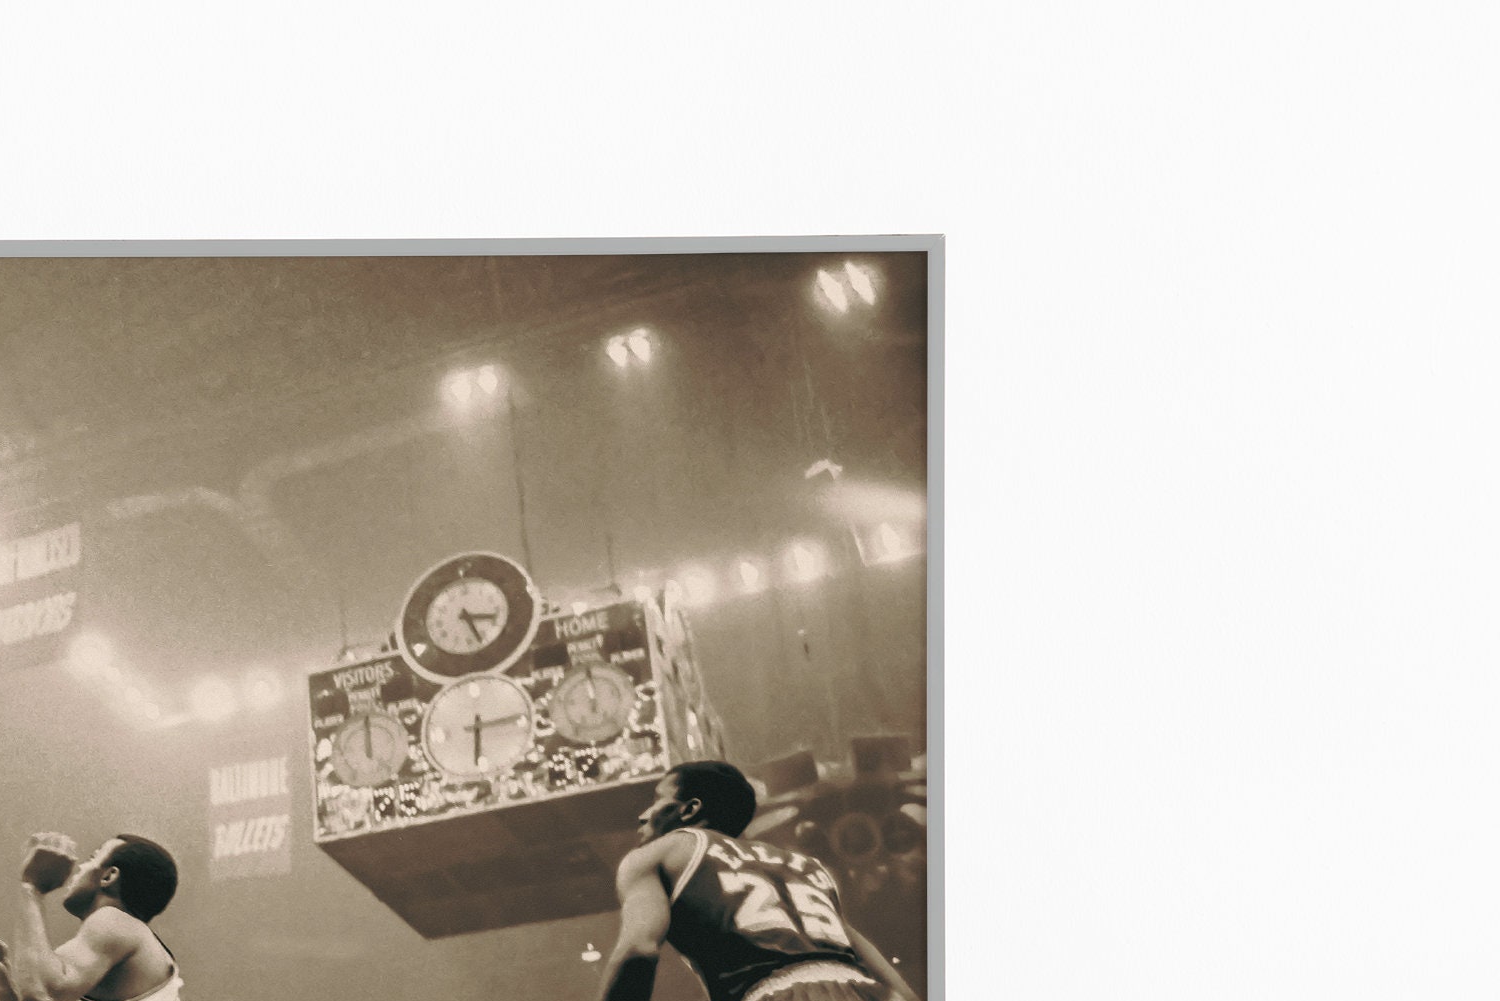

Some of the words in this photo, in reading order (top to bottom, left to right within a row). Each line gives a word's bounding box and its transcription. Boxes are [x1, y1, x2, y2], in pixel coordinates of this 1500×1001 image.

[554, 611, 610, 639] HOME
[333, 661, 395, 690] VISITORS
[707, 839, 833, 889] ELLIS
[717, 871, 851, 946] 25
